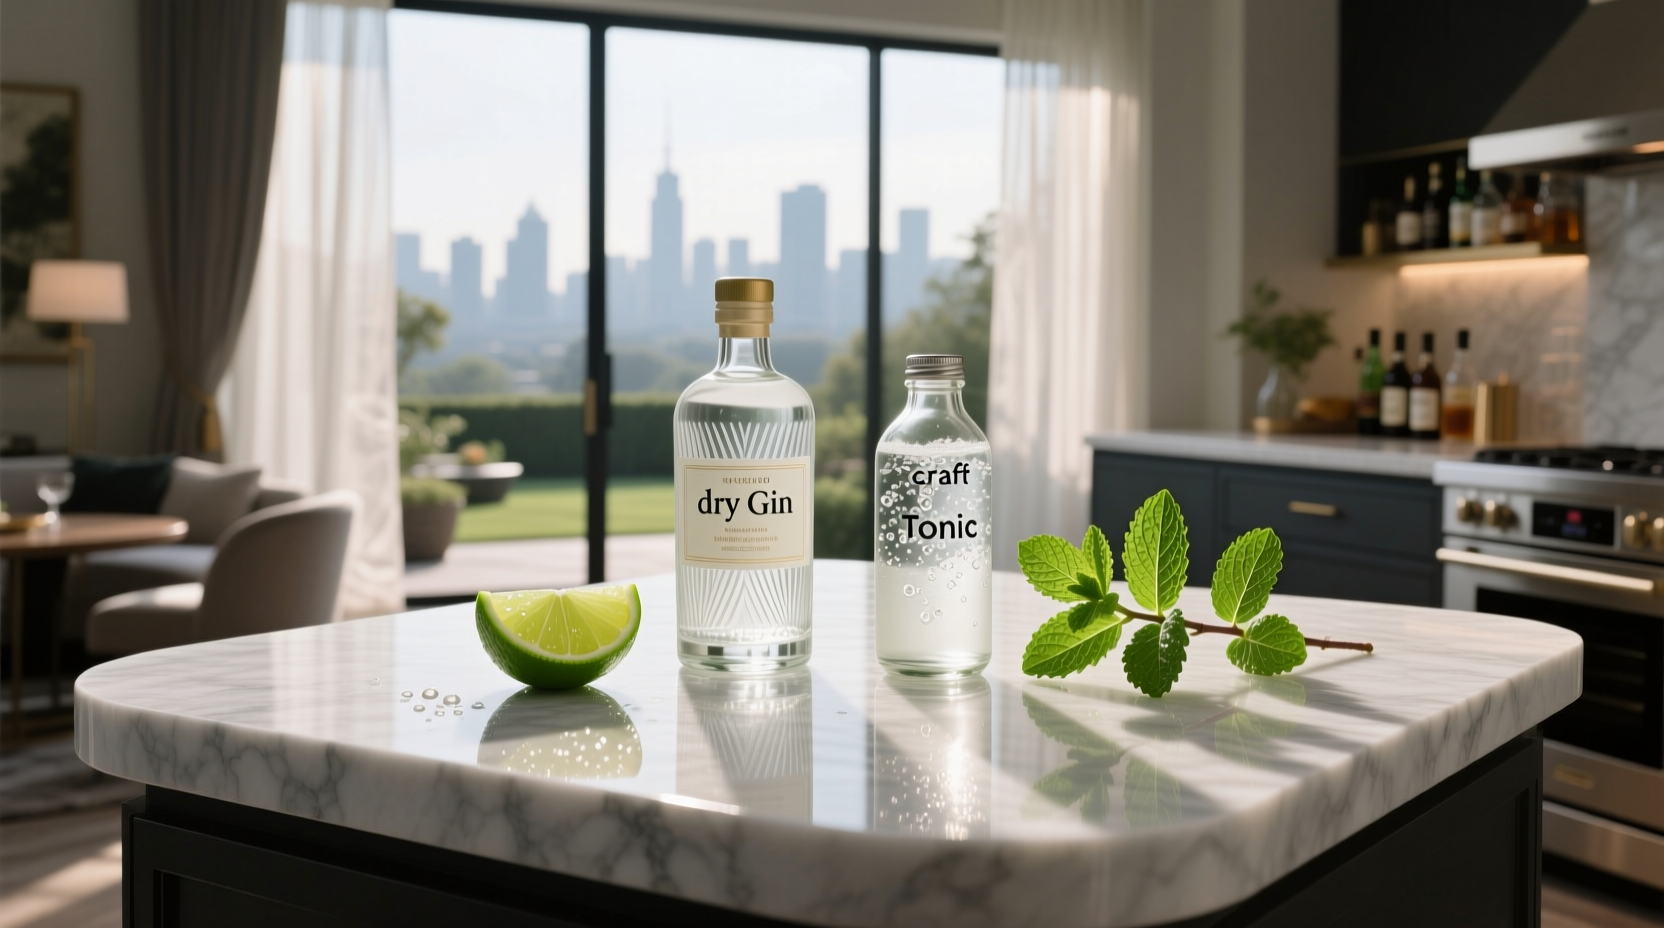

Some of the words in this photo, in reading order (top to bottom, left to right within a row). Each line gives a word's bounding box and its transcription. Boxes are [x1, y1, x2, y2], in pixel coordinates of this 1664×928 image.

[697, 488, 741, 523] dry
[747, 490, 793, 516] Gin
[901, 513, 978, 540] Tonic
